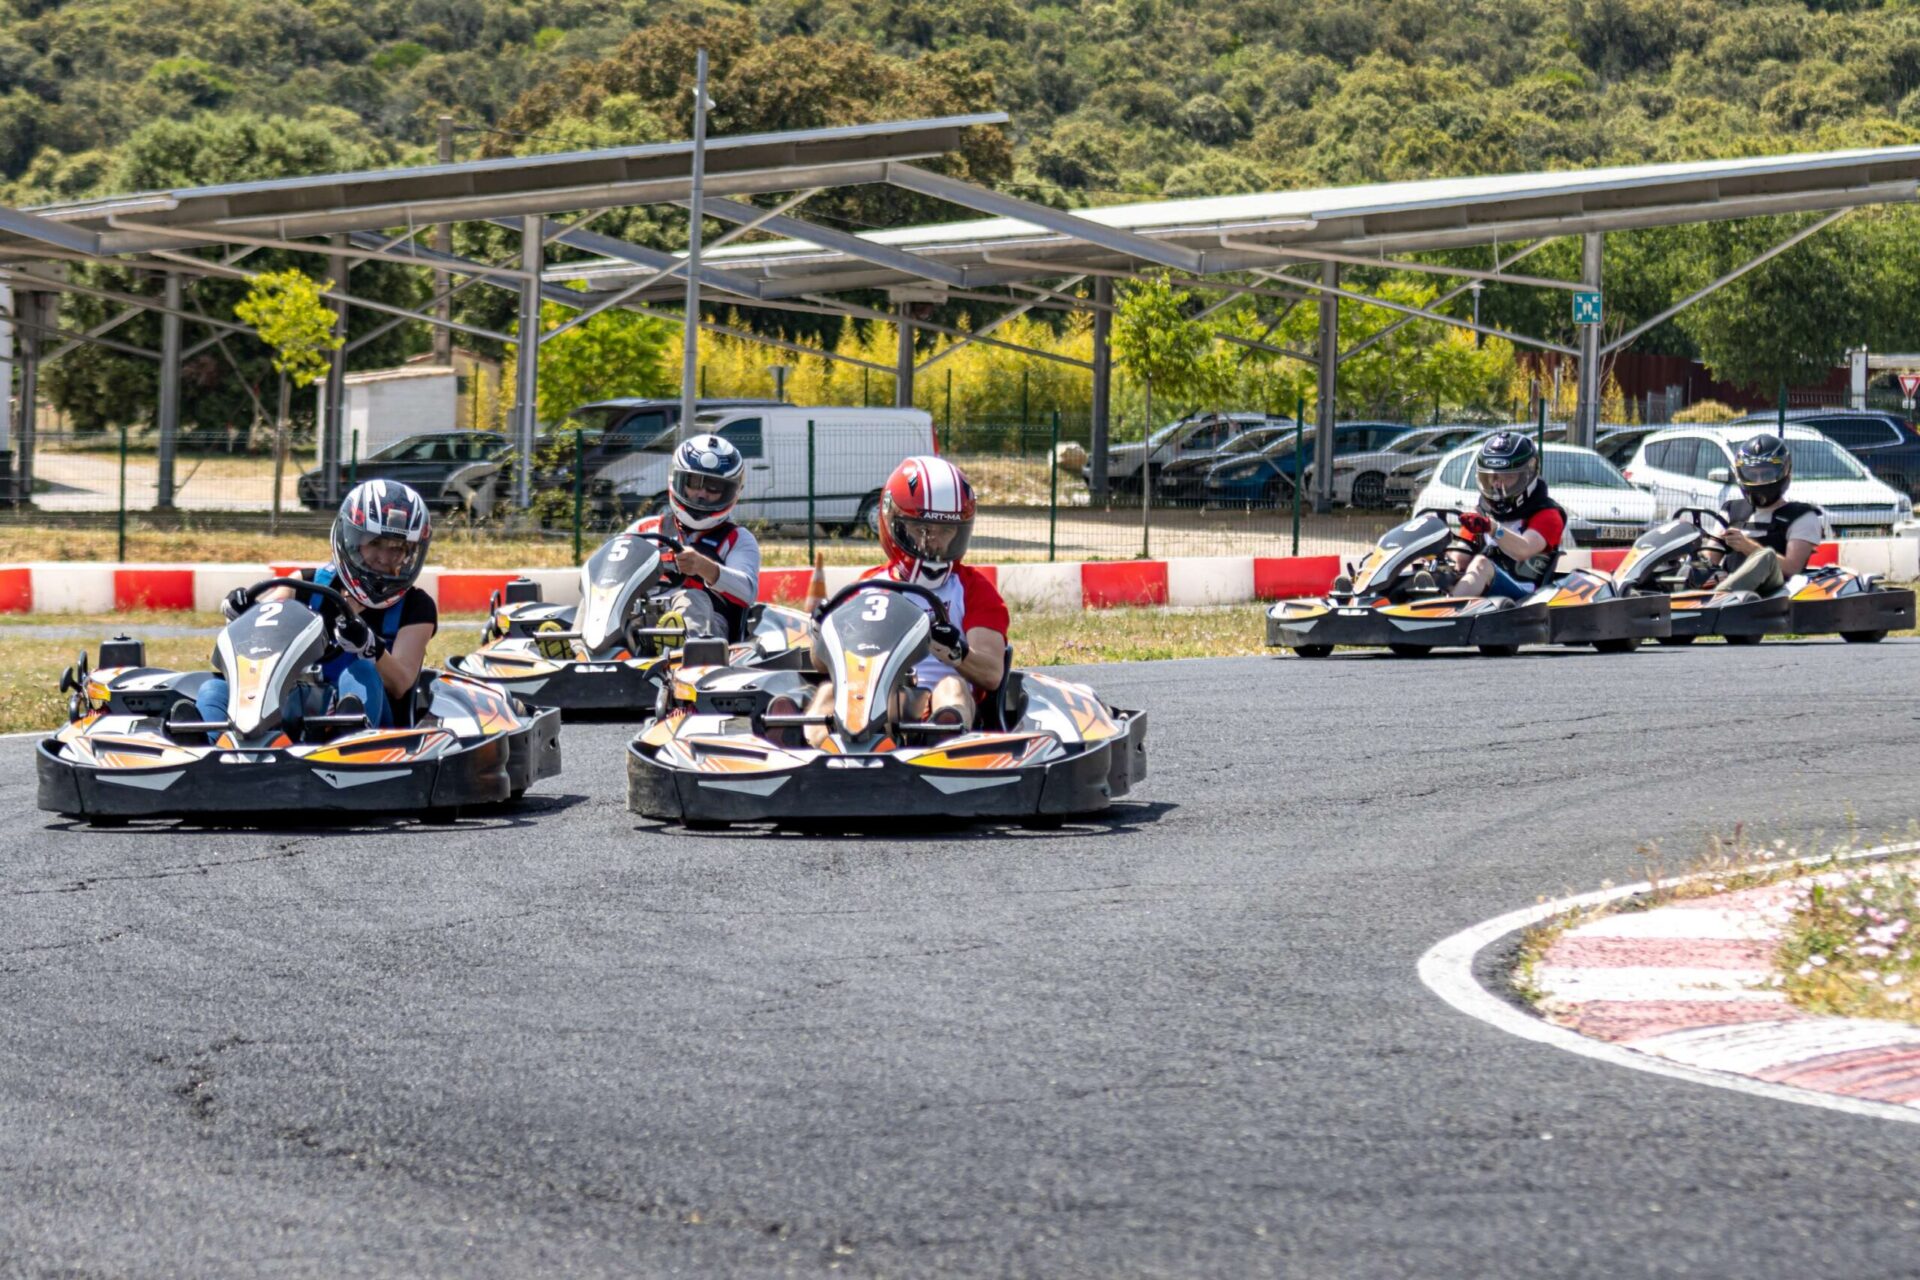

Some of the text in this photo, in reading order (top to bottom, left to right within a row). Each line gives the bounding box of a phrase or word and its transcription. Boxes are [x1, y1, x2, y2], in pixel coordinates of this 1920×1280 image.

[923, 511, 961, 521] ART-MA
[607, 539, 632, 562] 5
[254, 602, 284, 627] 2
[861, 594, 889, 622] 3
